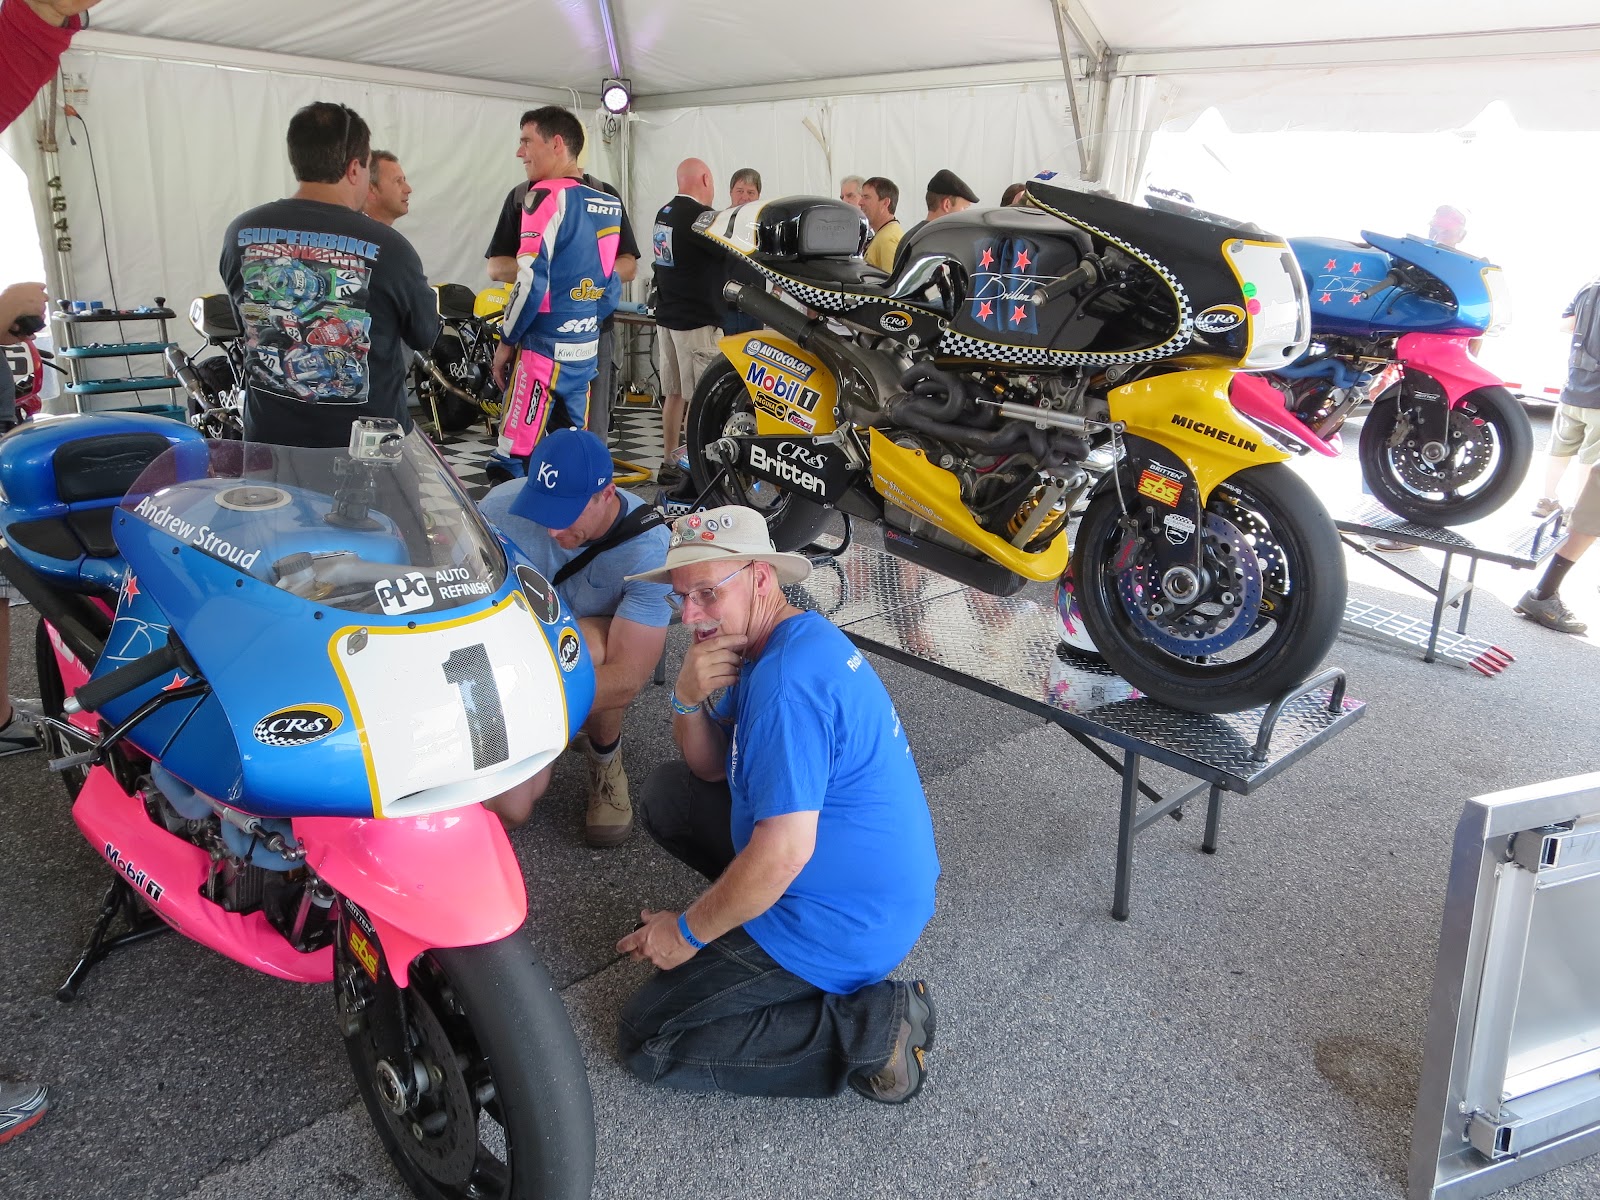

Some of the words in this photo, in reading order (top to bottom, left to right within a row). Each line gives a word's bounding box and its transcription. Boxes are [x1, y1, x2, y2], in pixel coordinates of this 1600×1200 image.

[238, 228, 380, 261] SUPERBIKE
[287, 327, 300, 341] 32
[1203, 313, 1238, 324] CR&S
[557, 349, 574, 358] Kiwi
[760, 344, 812, 375] AUTOCOLOR
[746, 361, 801, 403] Mobil
[510, 371, 528, 430] BRITTEN
[1171, 413, 1258, 453] MICHELIN
[750, 444, 826, 497] Britten
[776, 441, 829, 470] CR&S
[537, 461, 559, 489] KC
[1149, 464, 1182, 480] BRITTEN
[1140, 476, 1180, 503] sbs
[134, 496, 195, 539] Andrew
[193, 525, 261, 570] Stroud
[435, 567, 470, 584] AUTO
[438, 581, 492, 600] REFINISH
[441, 642, 510, 771] 1
[268, 716, 329, 736] CR&S
[105, 842, 147, 889] Mobil
[345, 898, 372, 934] BRITTEN
[350, 931, 377, 974] sbs
